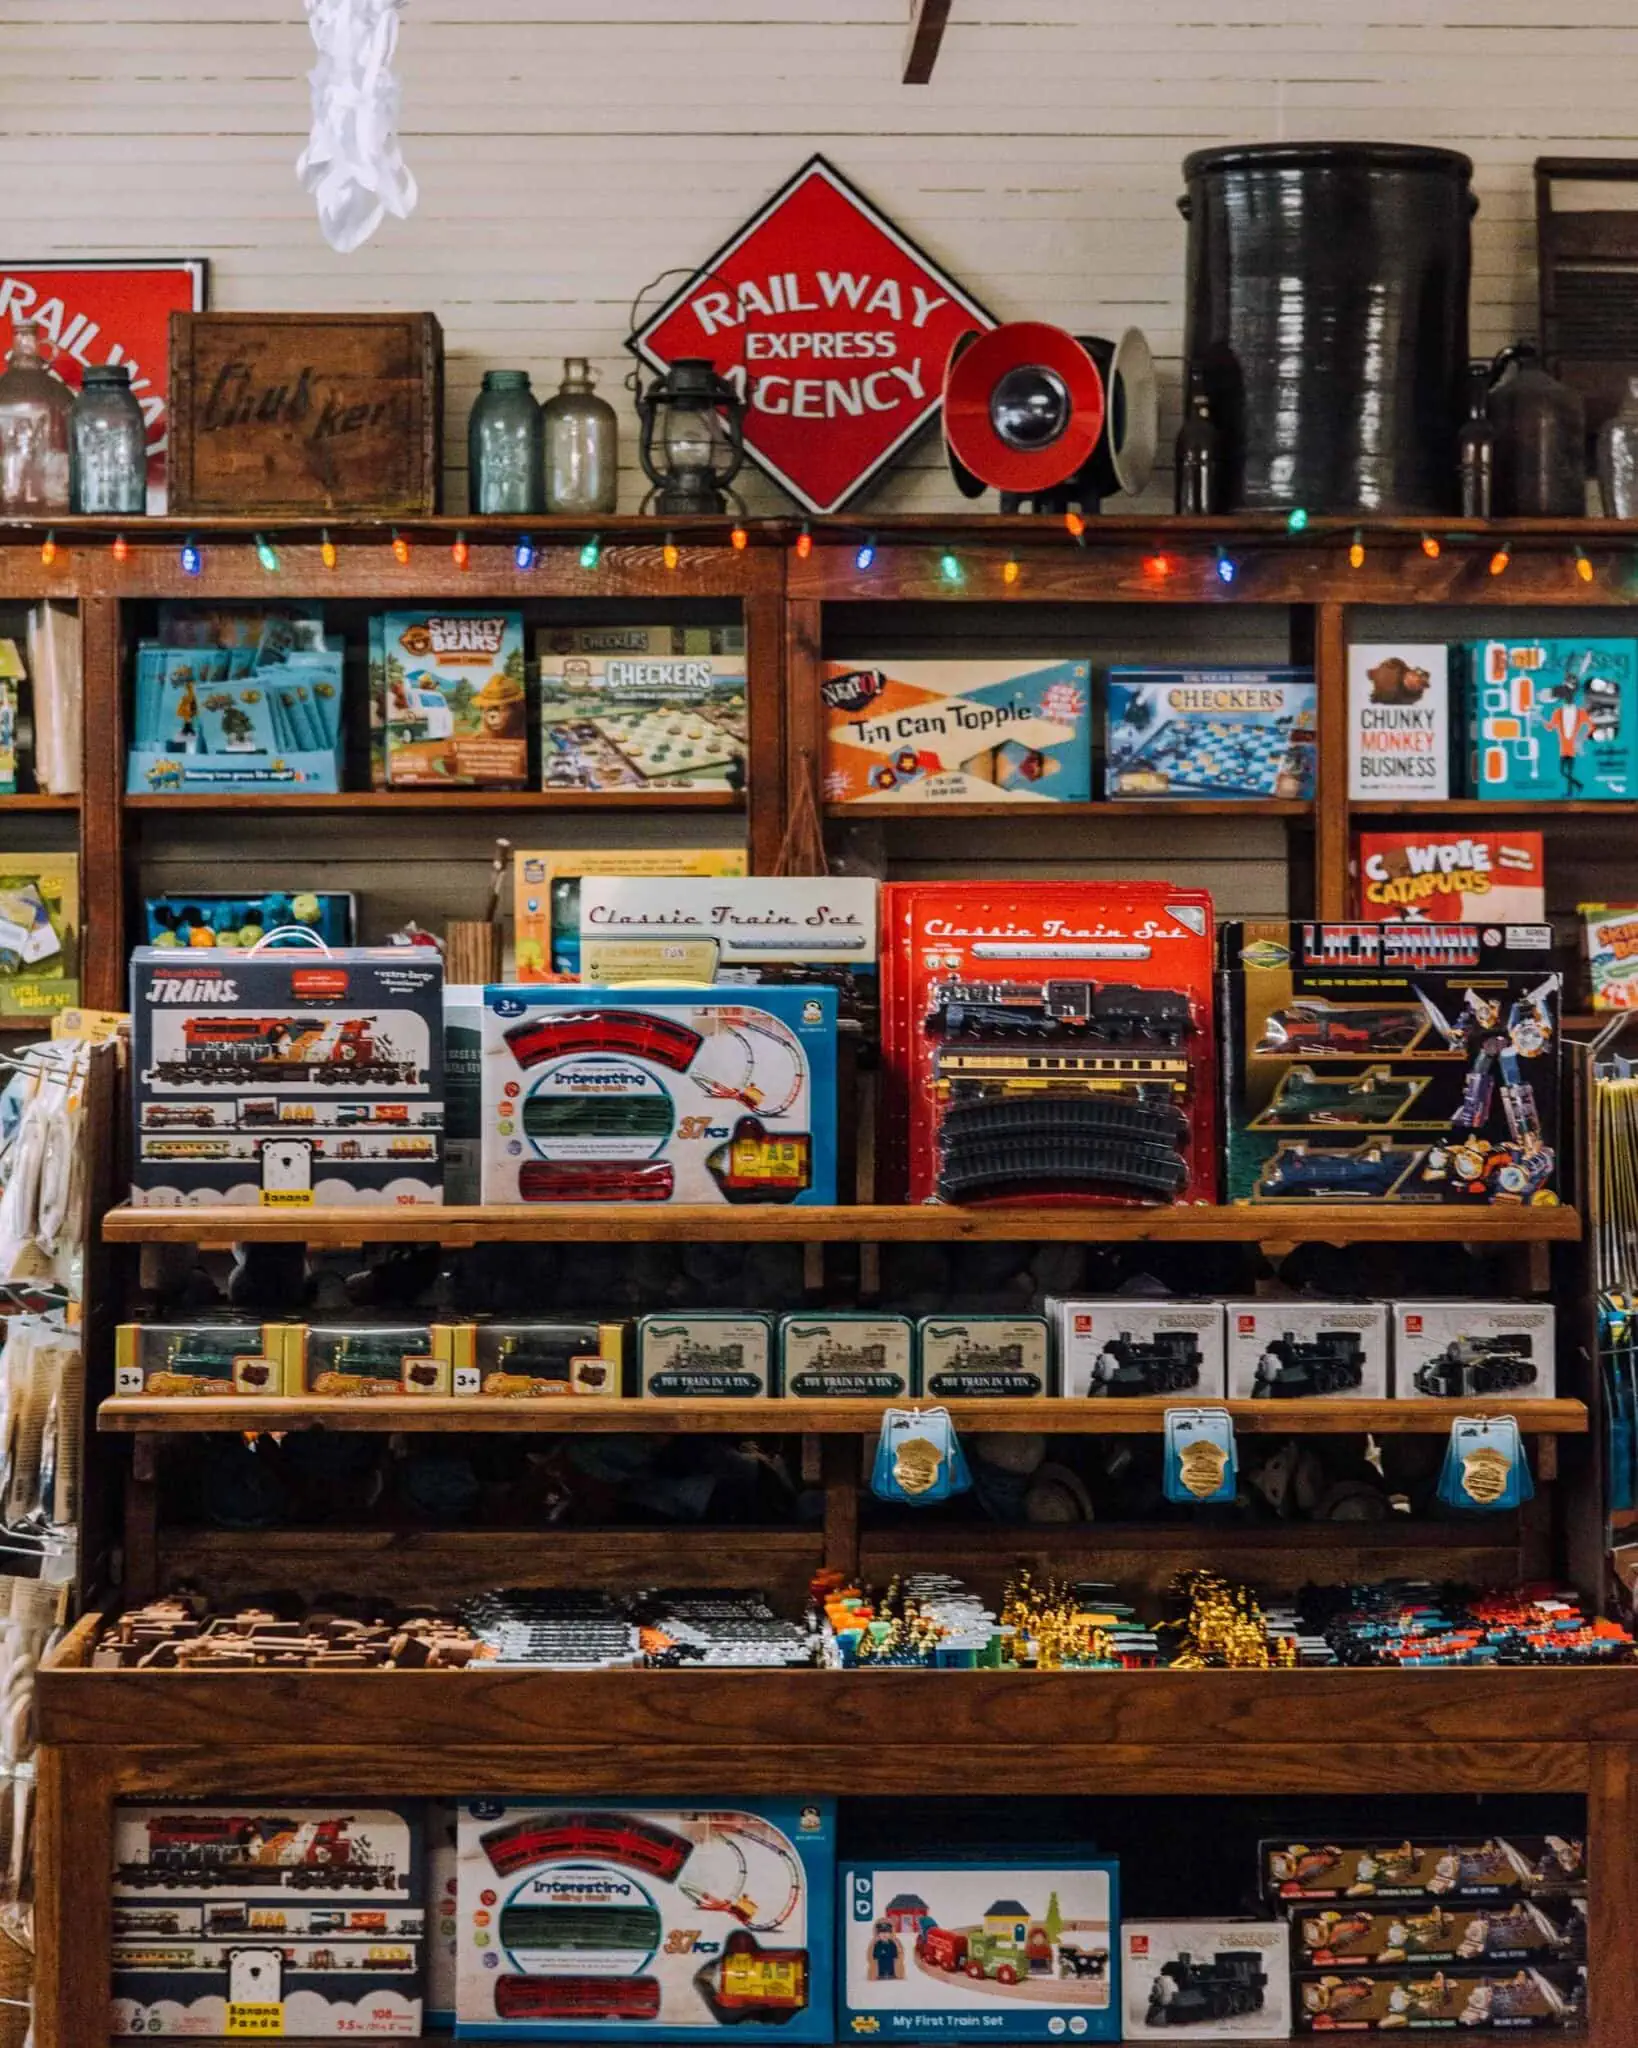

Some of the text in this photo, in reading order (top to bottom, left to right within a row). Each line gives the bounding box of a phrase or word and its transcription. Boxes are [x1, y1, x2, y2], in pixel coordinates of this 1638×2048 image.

[692, 271, 948, 336] RAILWAY
[745, 331, 897, 361] EXPRESS
[720, 358, 926, 418] AGENCY
[607, 661, 712, 688] CHECKERS
[1168, 688, 1284, 708] CHECKERS
[849, 720, 891, 744] Tin
[896, 716, 946, 738] Can
[947, 702, 1032, 729] Topple
[1361, 708, 1435, 729] CHUNKY
[1361, 731, 1436, 752] MONKEY
[1360, 756, 1437, 777] BUSINESS
[1366, 870, 1493, 904] CATAPULTS
[589, 905, 863, 927] Classic Train Set
[924, 919, 1188, 939] Classic Train Set
[554, 1073, 646, 1086] Interesting
[677, 1116, 730, 1140] 37 PCS
[120, 1372, 141, 1387] 3+
[457, 1372, 478, 1387] 3+
[533, 1880, 632, 1897] Interesting
[664, 1929, 702, 1954] 37
[229, 2004, 280, 2015] Banana
[229, 2017, 281, 2029] Panda
[892, 2015, 1004, 2029] My First Train Set
